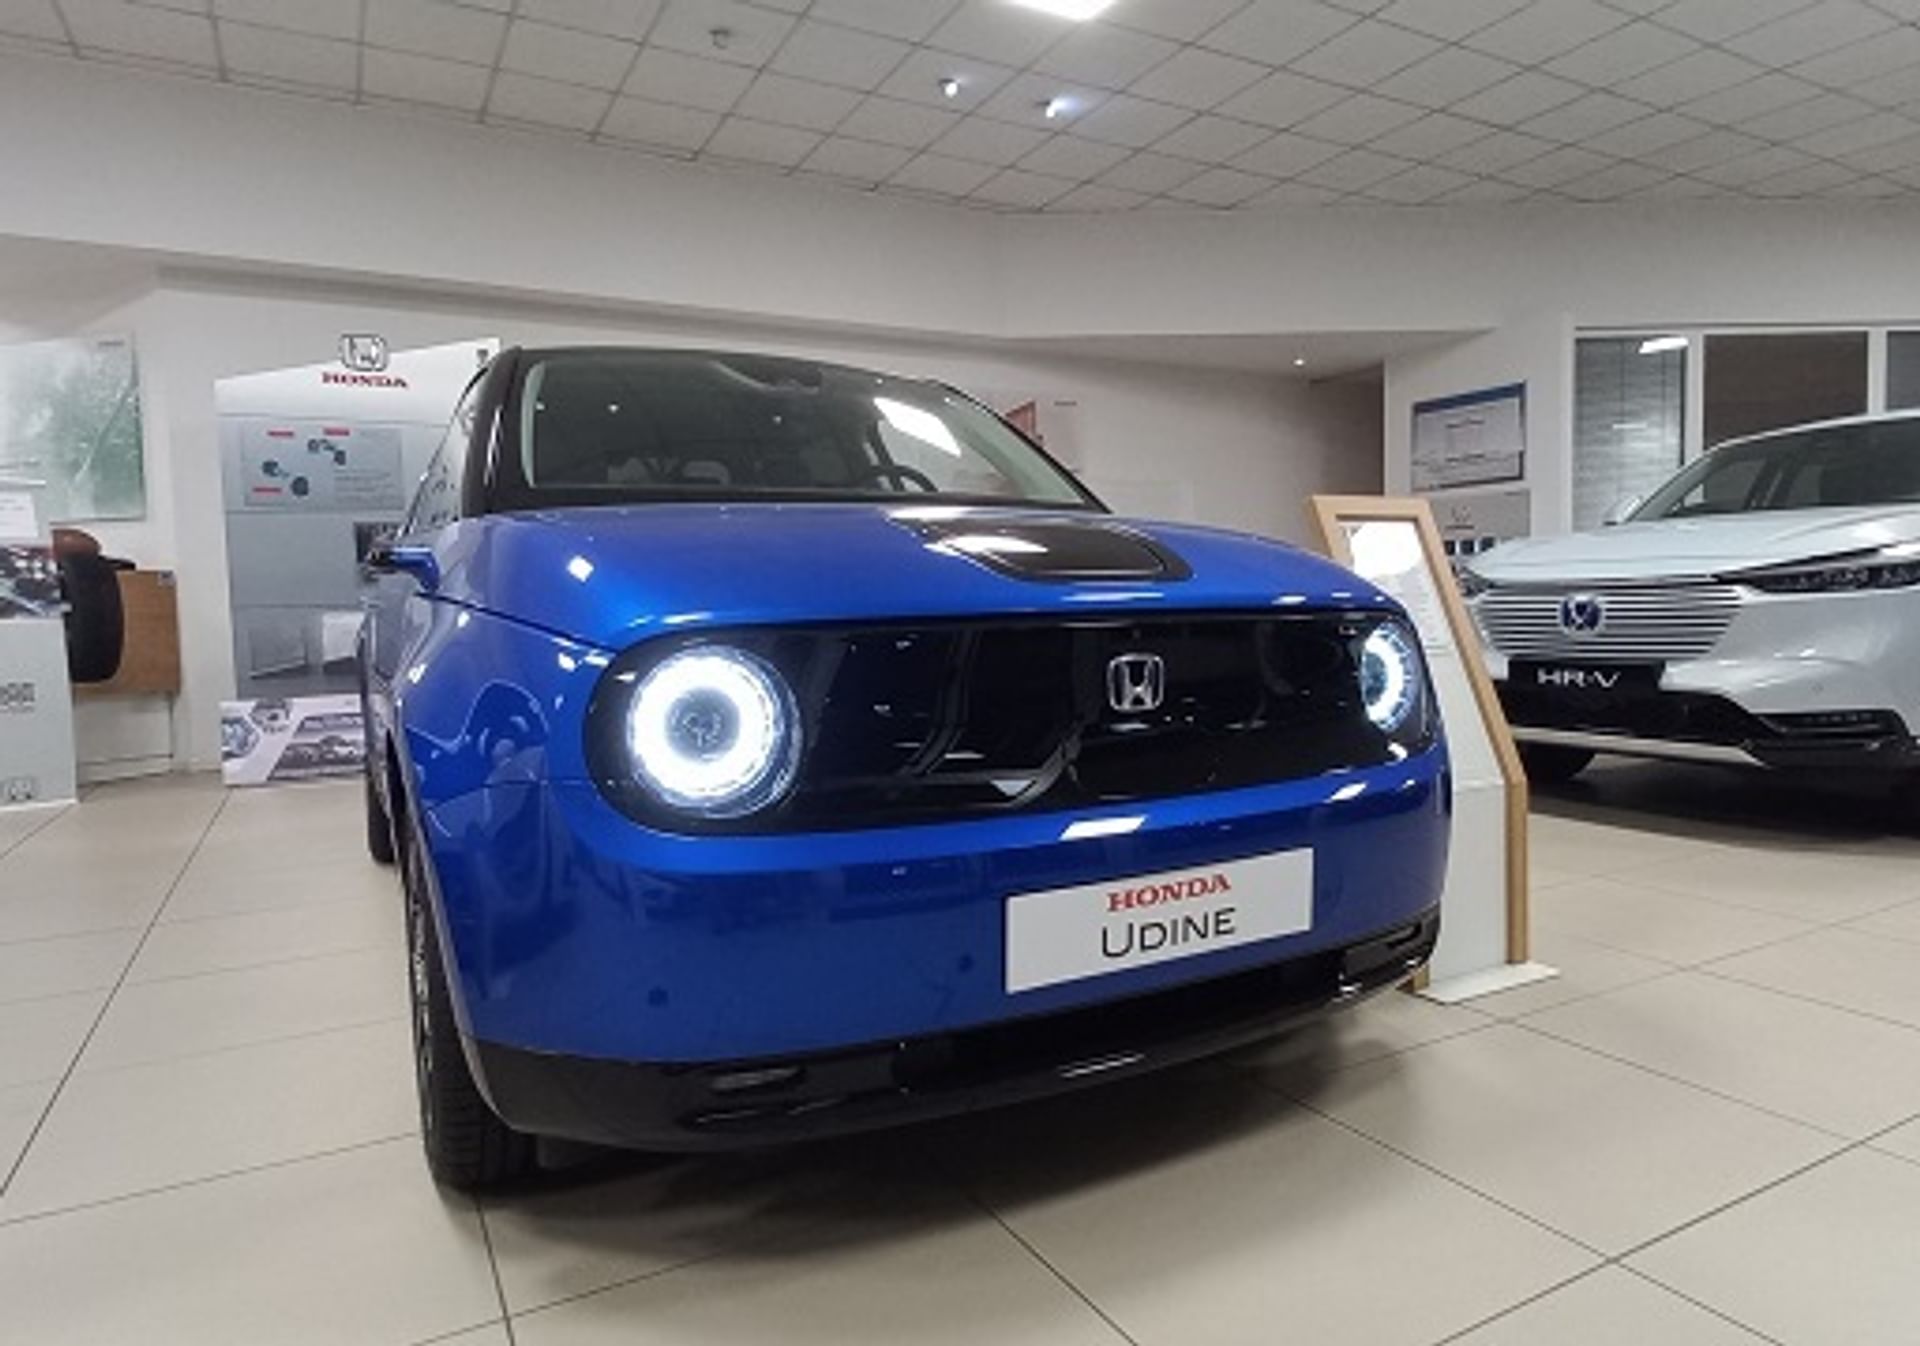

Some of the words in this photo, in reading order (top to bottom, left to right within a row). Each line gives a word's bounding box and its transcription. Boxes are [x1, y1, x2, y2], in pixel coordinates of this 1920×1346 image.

[322, 372, 408, 388] HONDA
[1537, 668, 1621, 688] HR-V
[1106, 873, 1231, 912] HONDA
[1102, 907, 1236, 958] UDINE
